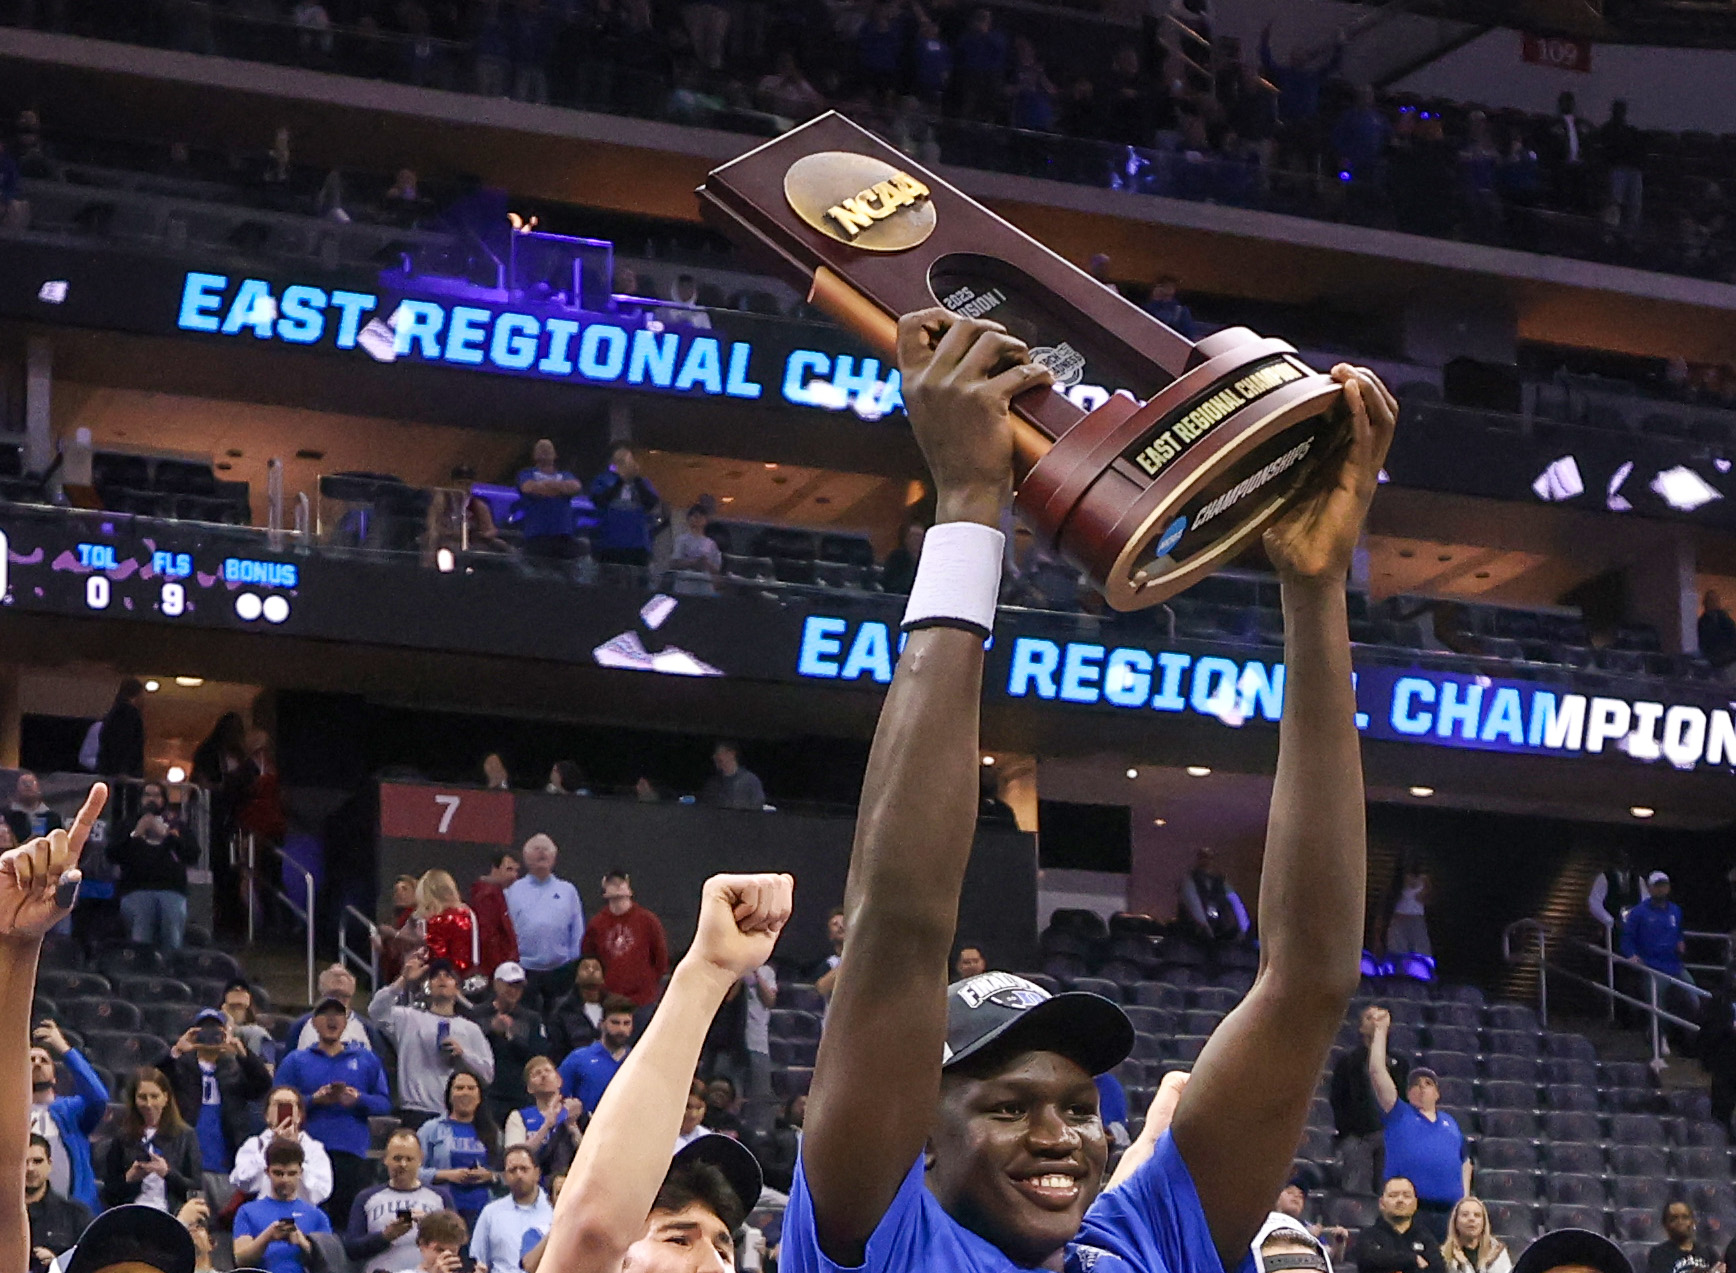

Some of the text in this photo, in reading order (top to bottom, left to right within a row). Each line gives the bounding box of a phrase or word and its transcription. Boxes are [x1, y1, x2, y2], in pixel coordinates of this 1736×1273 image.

[826, 171, 931, 240] NCAA
[178, 272, 376, 346] EAST
[392, 298, 762, 398] REGIONAL
[1136, 431, 1182, 476] EAST
[1172, 388, 1246, 443] REGIONAL
[1191, 436, 1314, 531] CHAMPIONSHIPS
[79, 543, 117, 568] TOL
[153, 551, 191, 576] FLS
[225, 557, 298, 587] BONUS
[86, 576, 110, 610] 0
[162, 582, 185, 617] 9
[1007, 637, 1369, 728] REGION
[435, 795, 461, 833] 7
